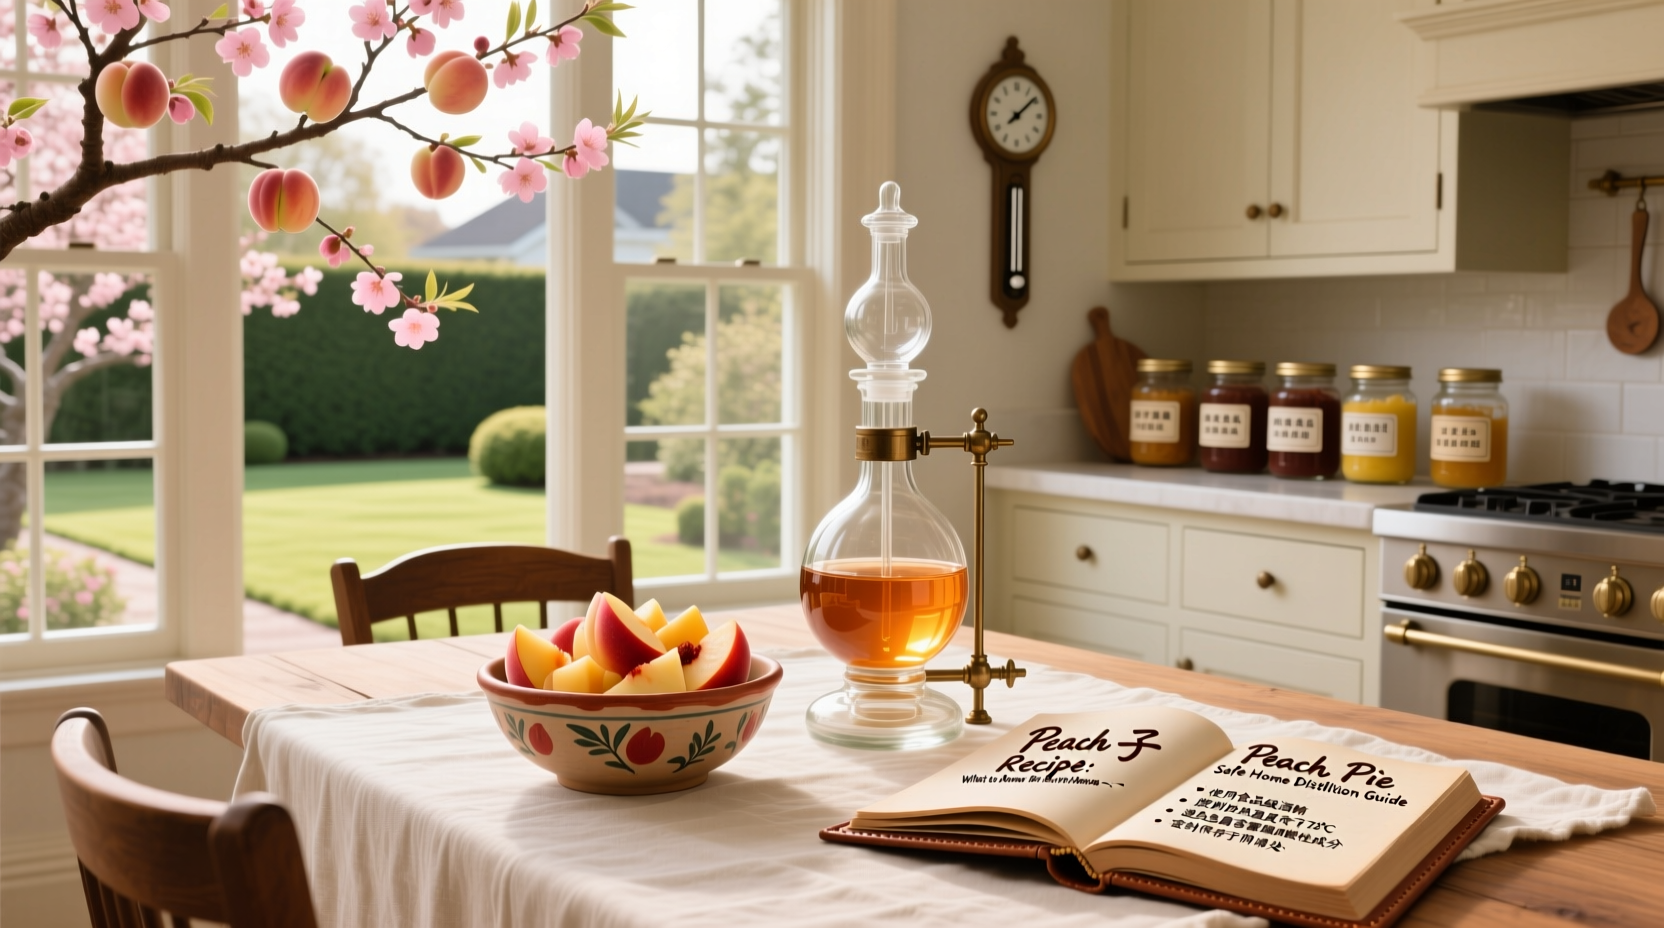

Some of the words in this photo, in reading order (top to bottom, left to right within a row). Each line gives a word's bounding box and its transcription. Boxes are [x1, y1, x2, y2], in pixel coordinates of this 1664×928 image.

[1019, 726, 1111, 753] Peach
[995, 755, 1095, 780] Recipe:
[1240, 744, 1331, 778] Peach
[1340, 762, 1395, 789] Pie
[1213, 764, 1246, 777] Safe
[1249, 770, 1290, 785] Home
[1363, 790, 1408, 807] Guide
